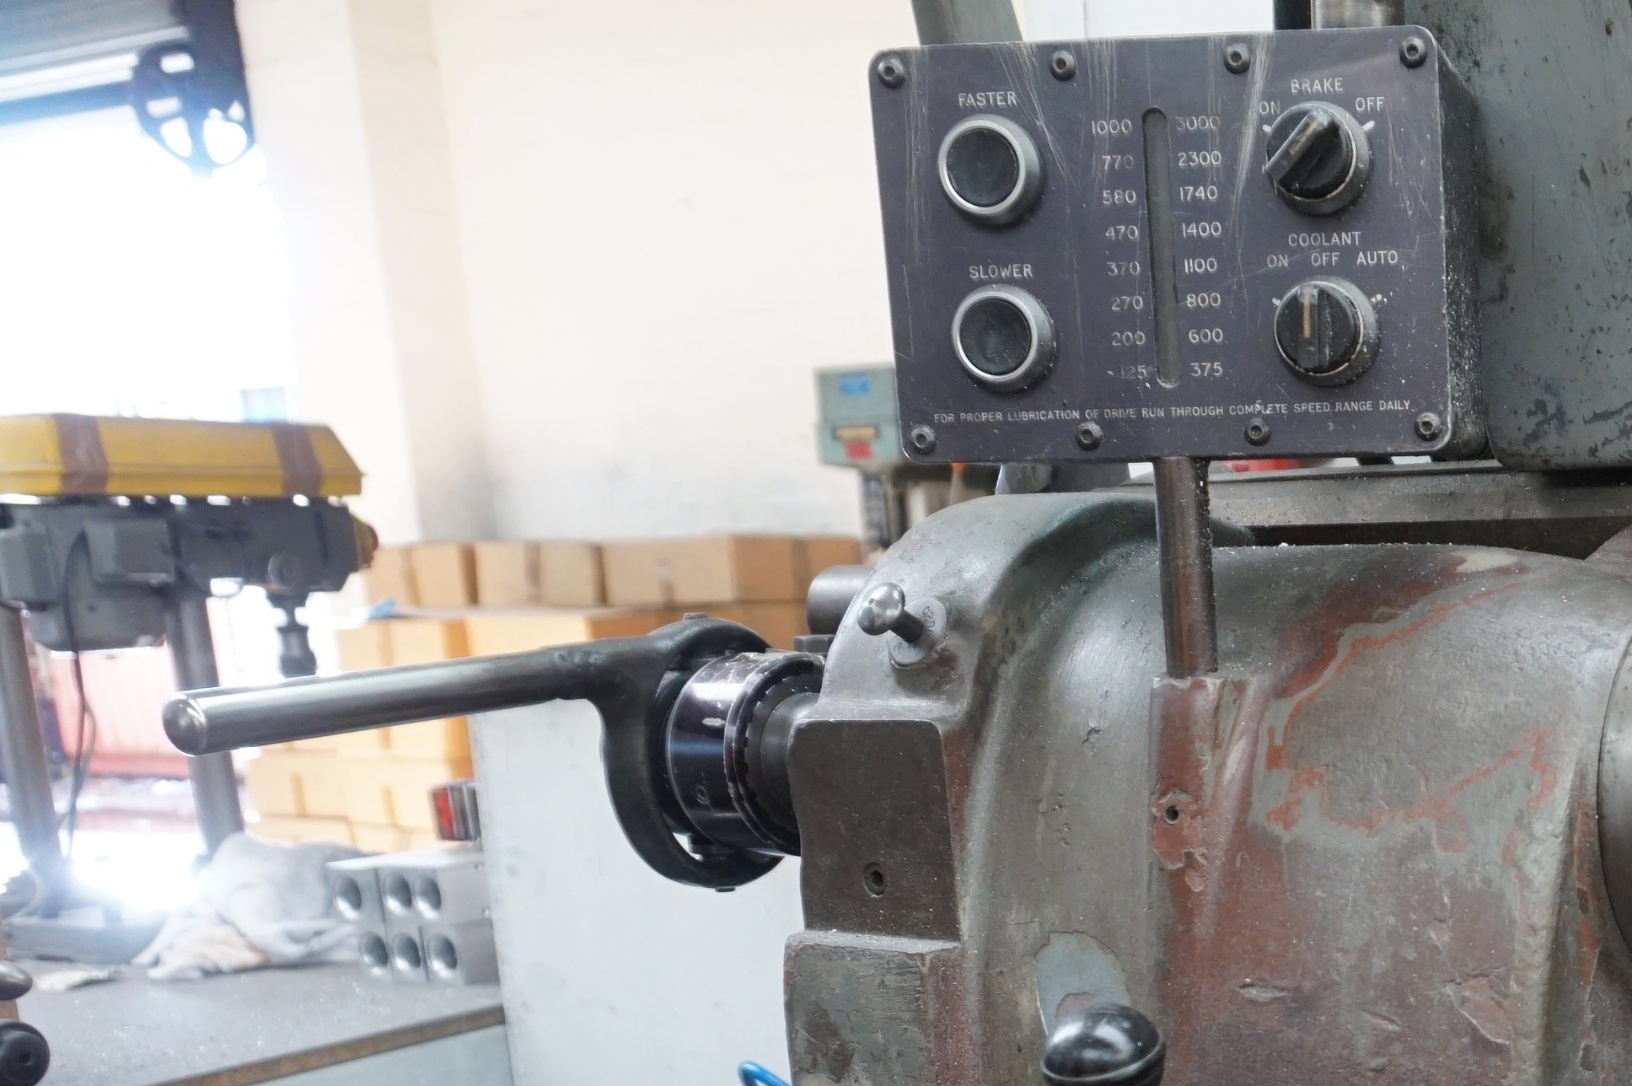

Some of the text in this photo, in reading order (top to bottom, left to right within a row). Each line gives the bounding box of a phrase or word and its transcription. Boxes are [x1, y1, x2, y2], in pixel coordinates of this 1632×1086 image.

[1290, 78, 1344, 94] BRAKE
[958, 91, 1018, 109] FASTER
[1259, 97, 1386, 115] ON OFF
[1091, 119, 1132, 135] 1000
[1176, 116, 1221, 131] 3000
[1101, 155, 1134, 171] 770
[1178, 151, 1223, 168] 2300
[1102, 190, 1137, 205] 580
[1180, 185, 1218, 201] 1740
[1105, 226, 1139, 240] 470
[1182, 221, 1222, 238] 1400
[1288, 232, 1361, 247] COOLANT
[1184, 258, 1218, 274] 1100
[1267, 250, 1399, 268] ON OFF AUTO
[969, 263, 1033, 280] SLOWER
[1106, 261, 1141, 276] 370
[1111, 296, 1144, 311] 270
[1186, 293, 1221, 307] 800
[1111, 331, 1146, 346] 200
[1188, 328, 1224, 343] 600
[1190, 362, 1223, 377] 375
[934, 399, 1410, 424] FOR PROPER LUBRICATION OF DRIVE RUN THROUGH COMPLETE SPEED RANGE DAILY
